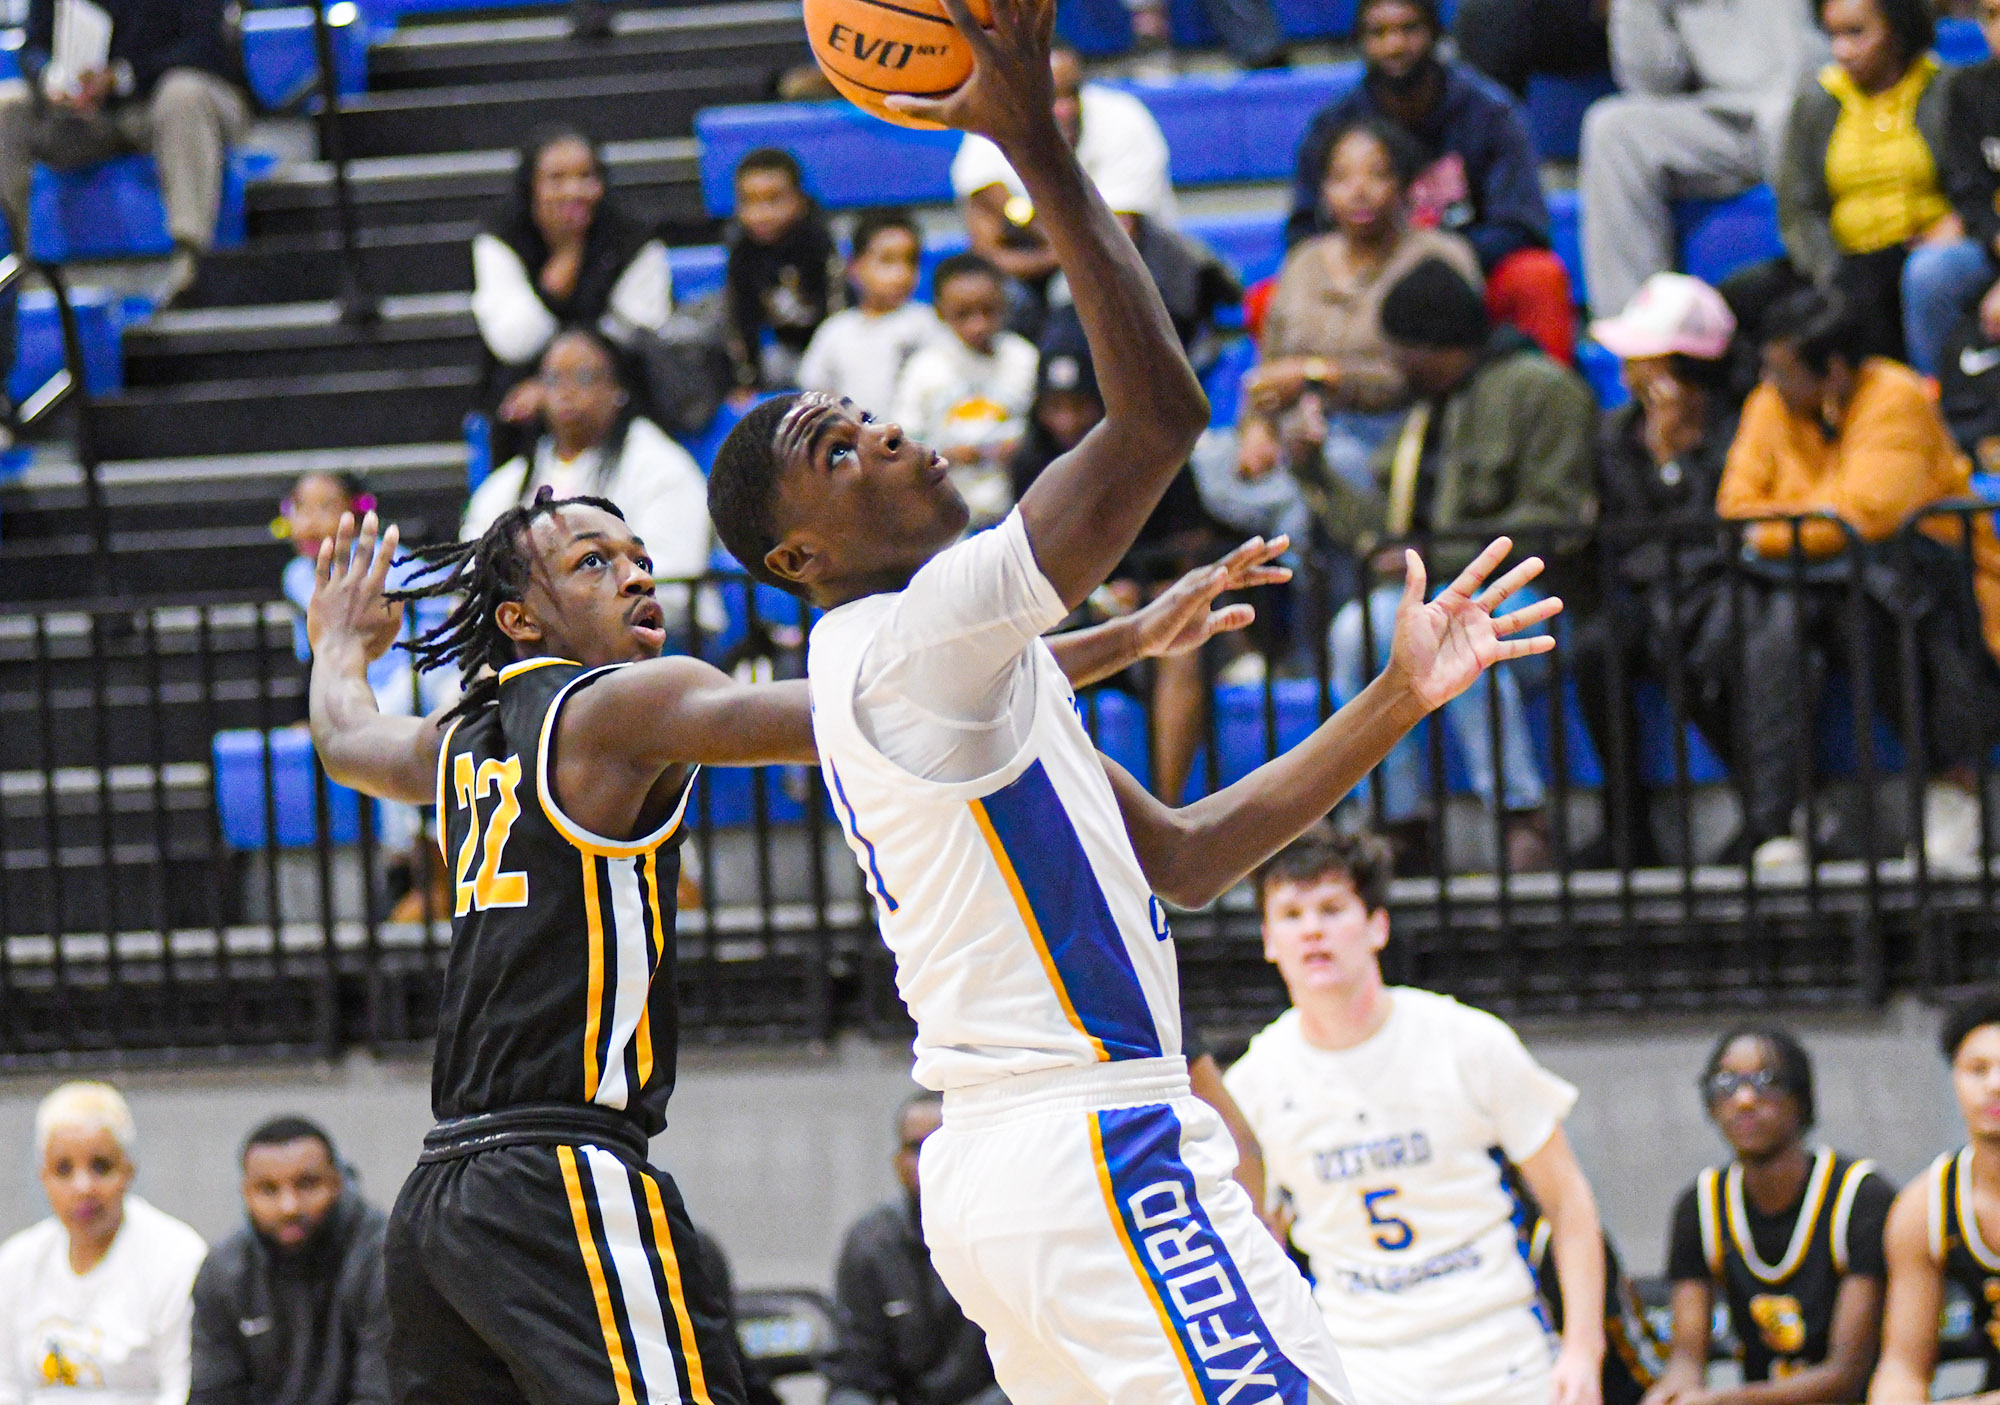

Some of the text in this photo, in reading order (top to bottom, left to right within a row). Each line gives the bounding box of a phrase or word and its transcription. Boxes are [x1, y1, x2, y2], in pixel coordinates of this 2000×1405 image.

[829, 23, 914, 70] EVO
[454, 751, 529, 918] 22
[1360, 1185, 1418, 1251] 5
